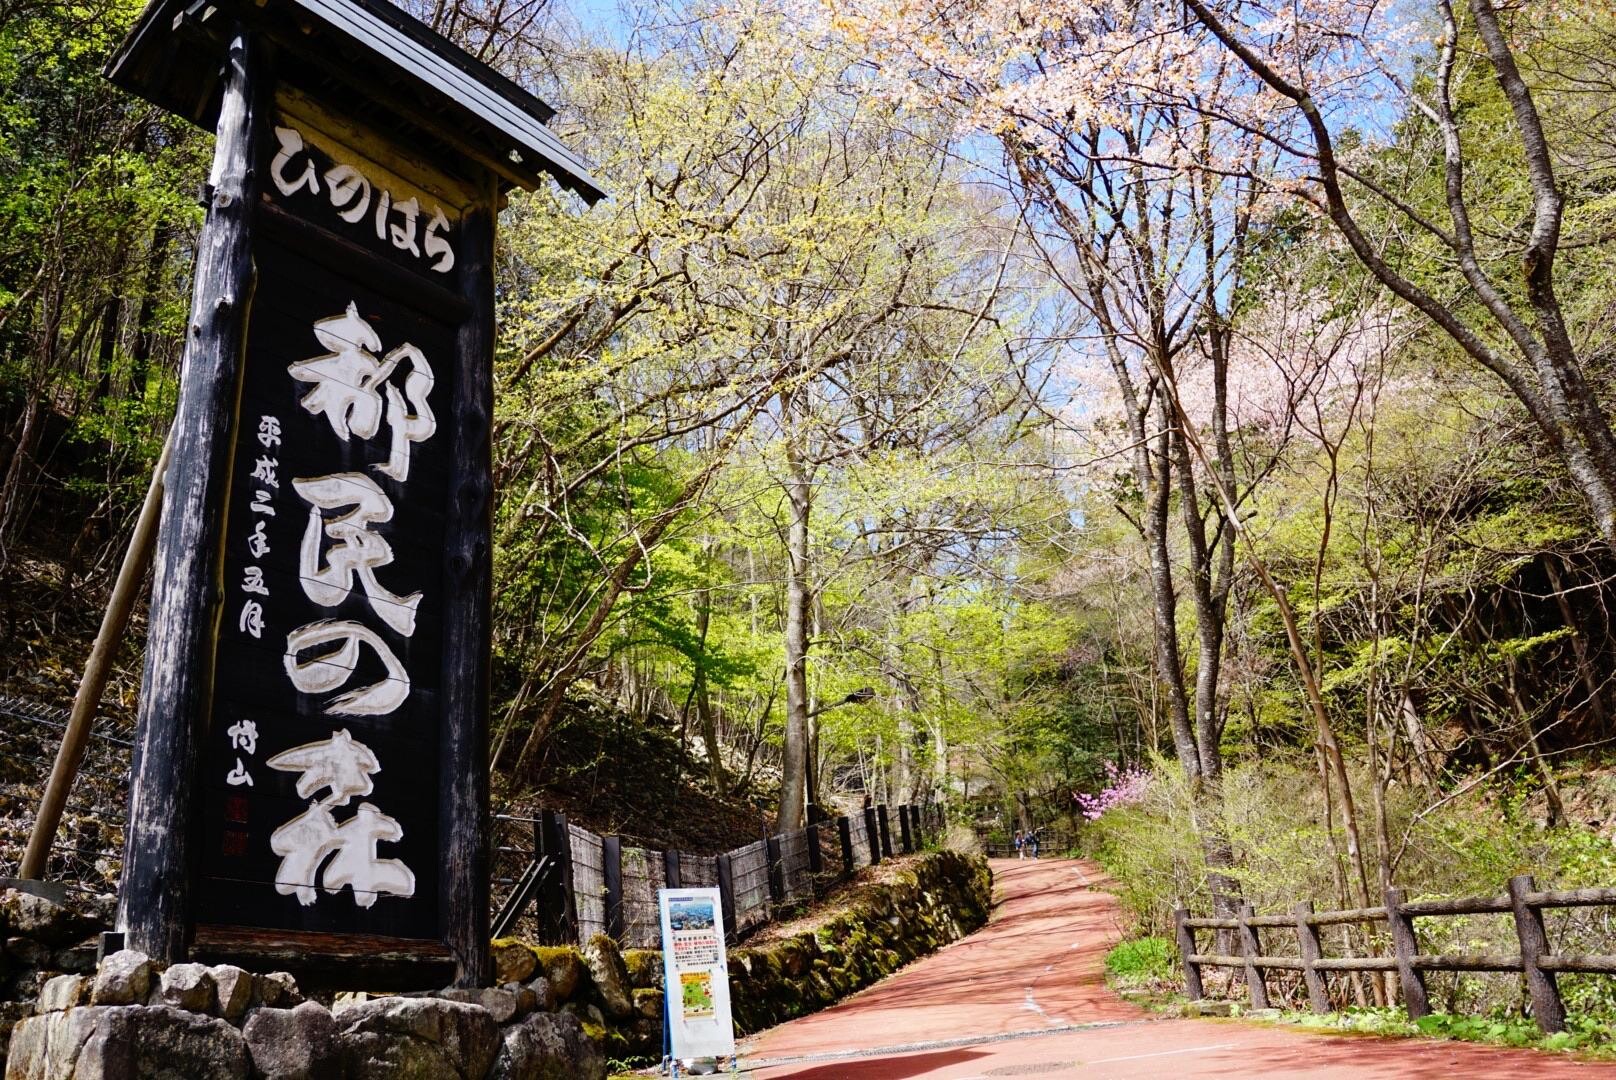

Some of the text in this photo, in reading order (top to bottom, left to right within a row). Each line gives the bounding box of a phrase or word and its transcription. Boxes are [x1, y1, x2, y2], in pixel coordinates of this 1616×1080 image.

[271, 126, 455, 273] ひのはら
[239, 415, 282, 639] 平成二年五月
[266, 300, 438, 910] 都民の森
